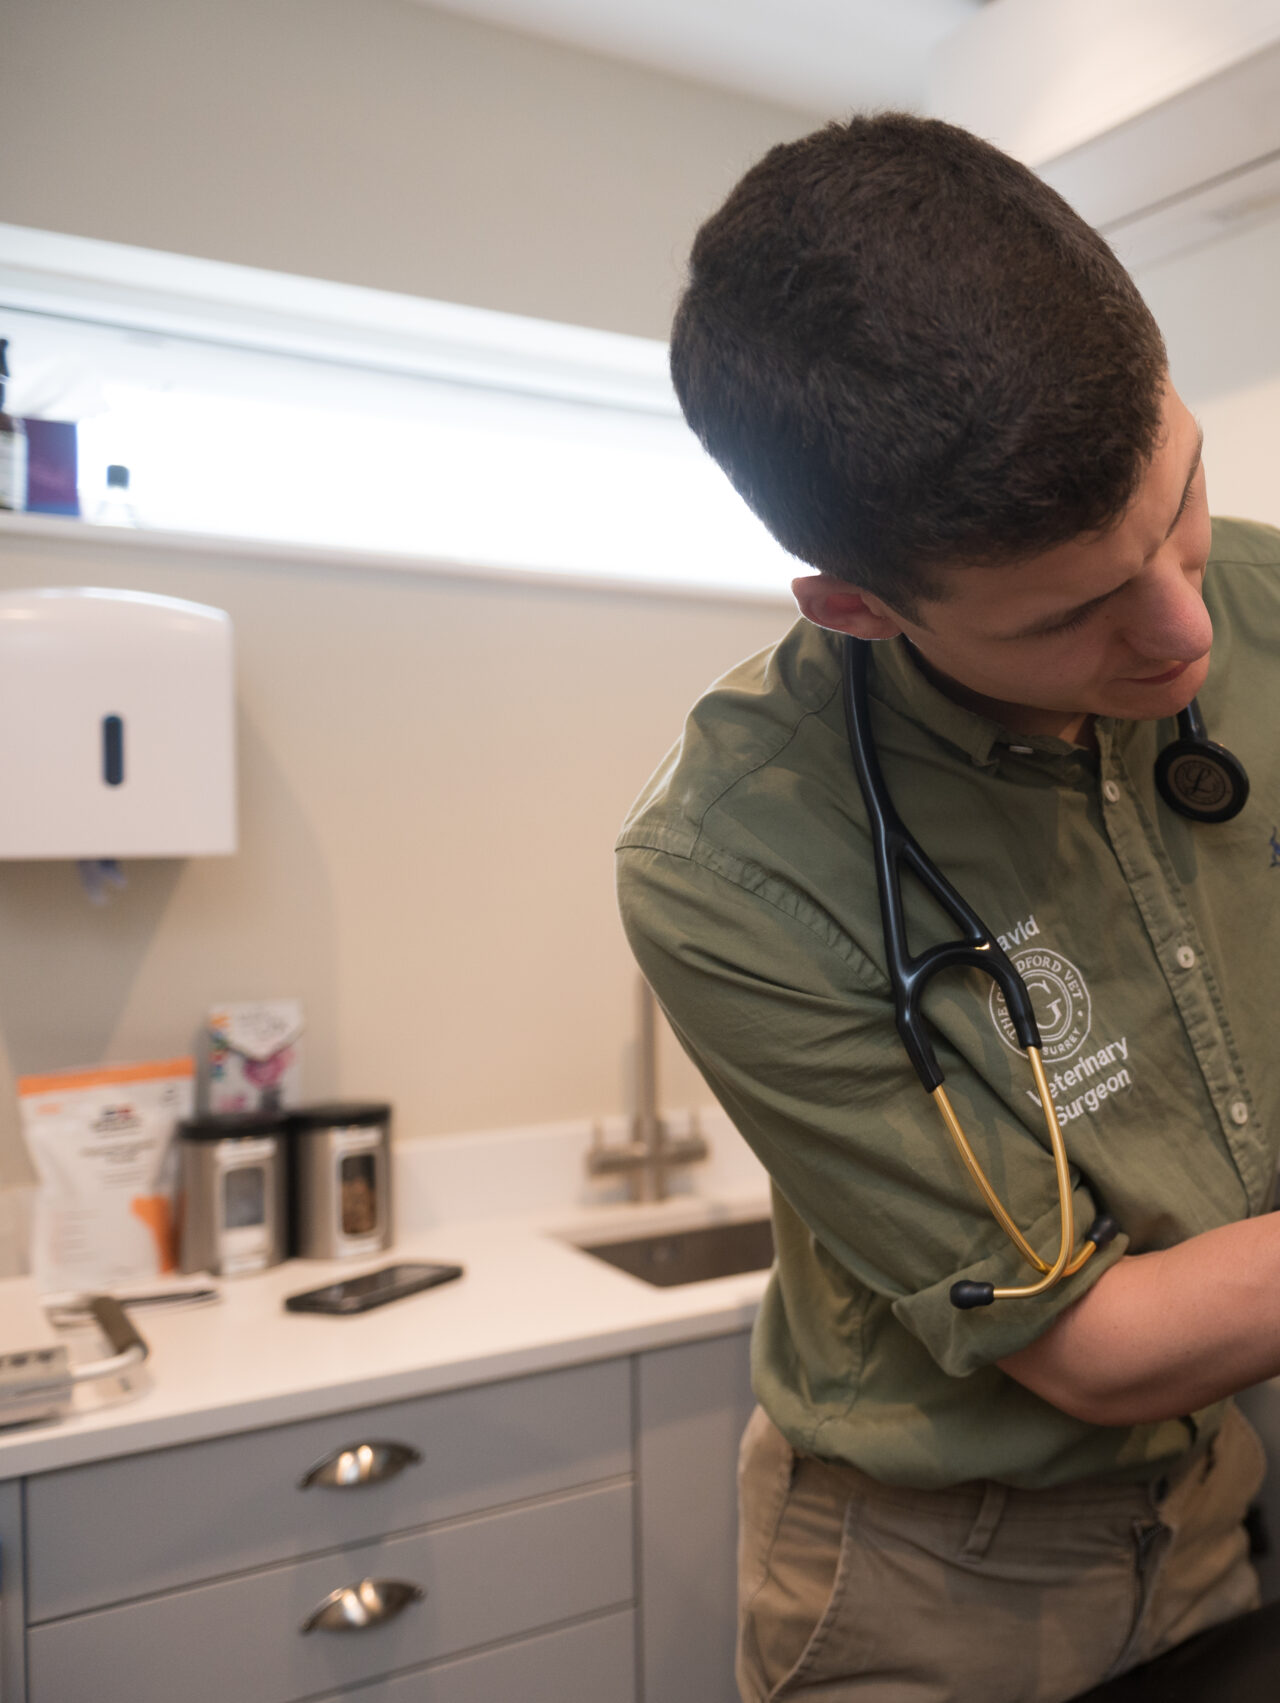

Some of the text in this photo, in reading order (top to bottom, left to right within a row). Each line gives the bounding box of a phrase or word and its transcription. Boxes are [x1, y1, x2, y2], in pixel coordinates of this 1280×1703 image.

[997, 914, 1041, 952] avid
[1064, 969, 1084, 1000] VET
[1026, 979, 1062, 1030] G
[1042, 1027, 1081, 1056] SURREY
[1055, 1068, 1132, 1127] Surgeon
